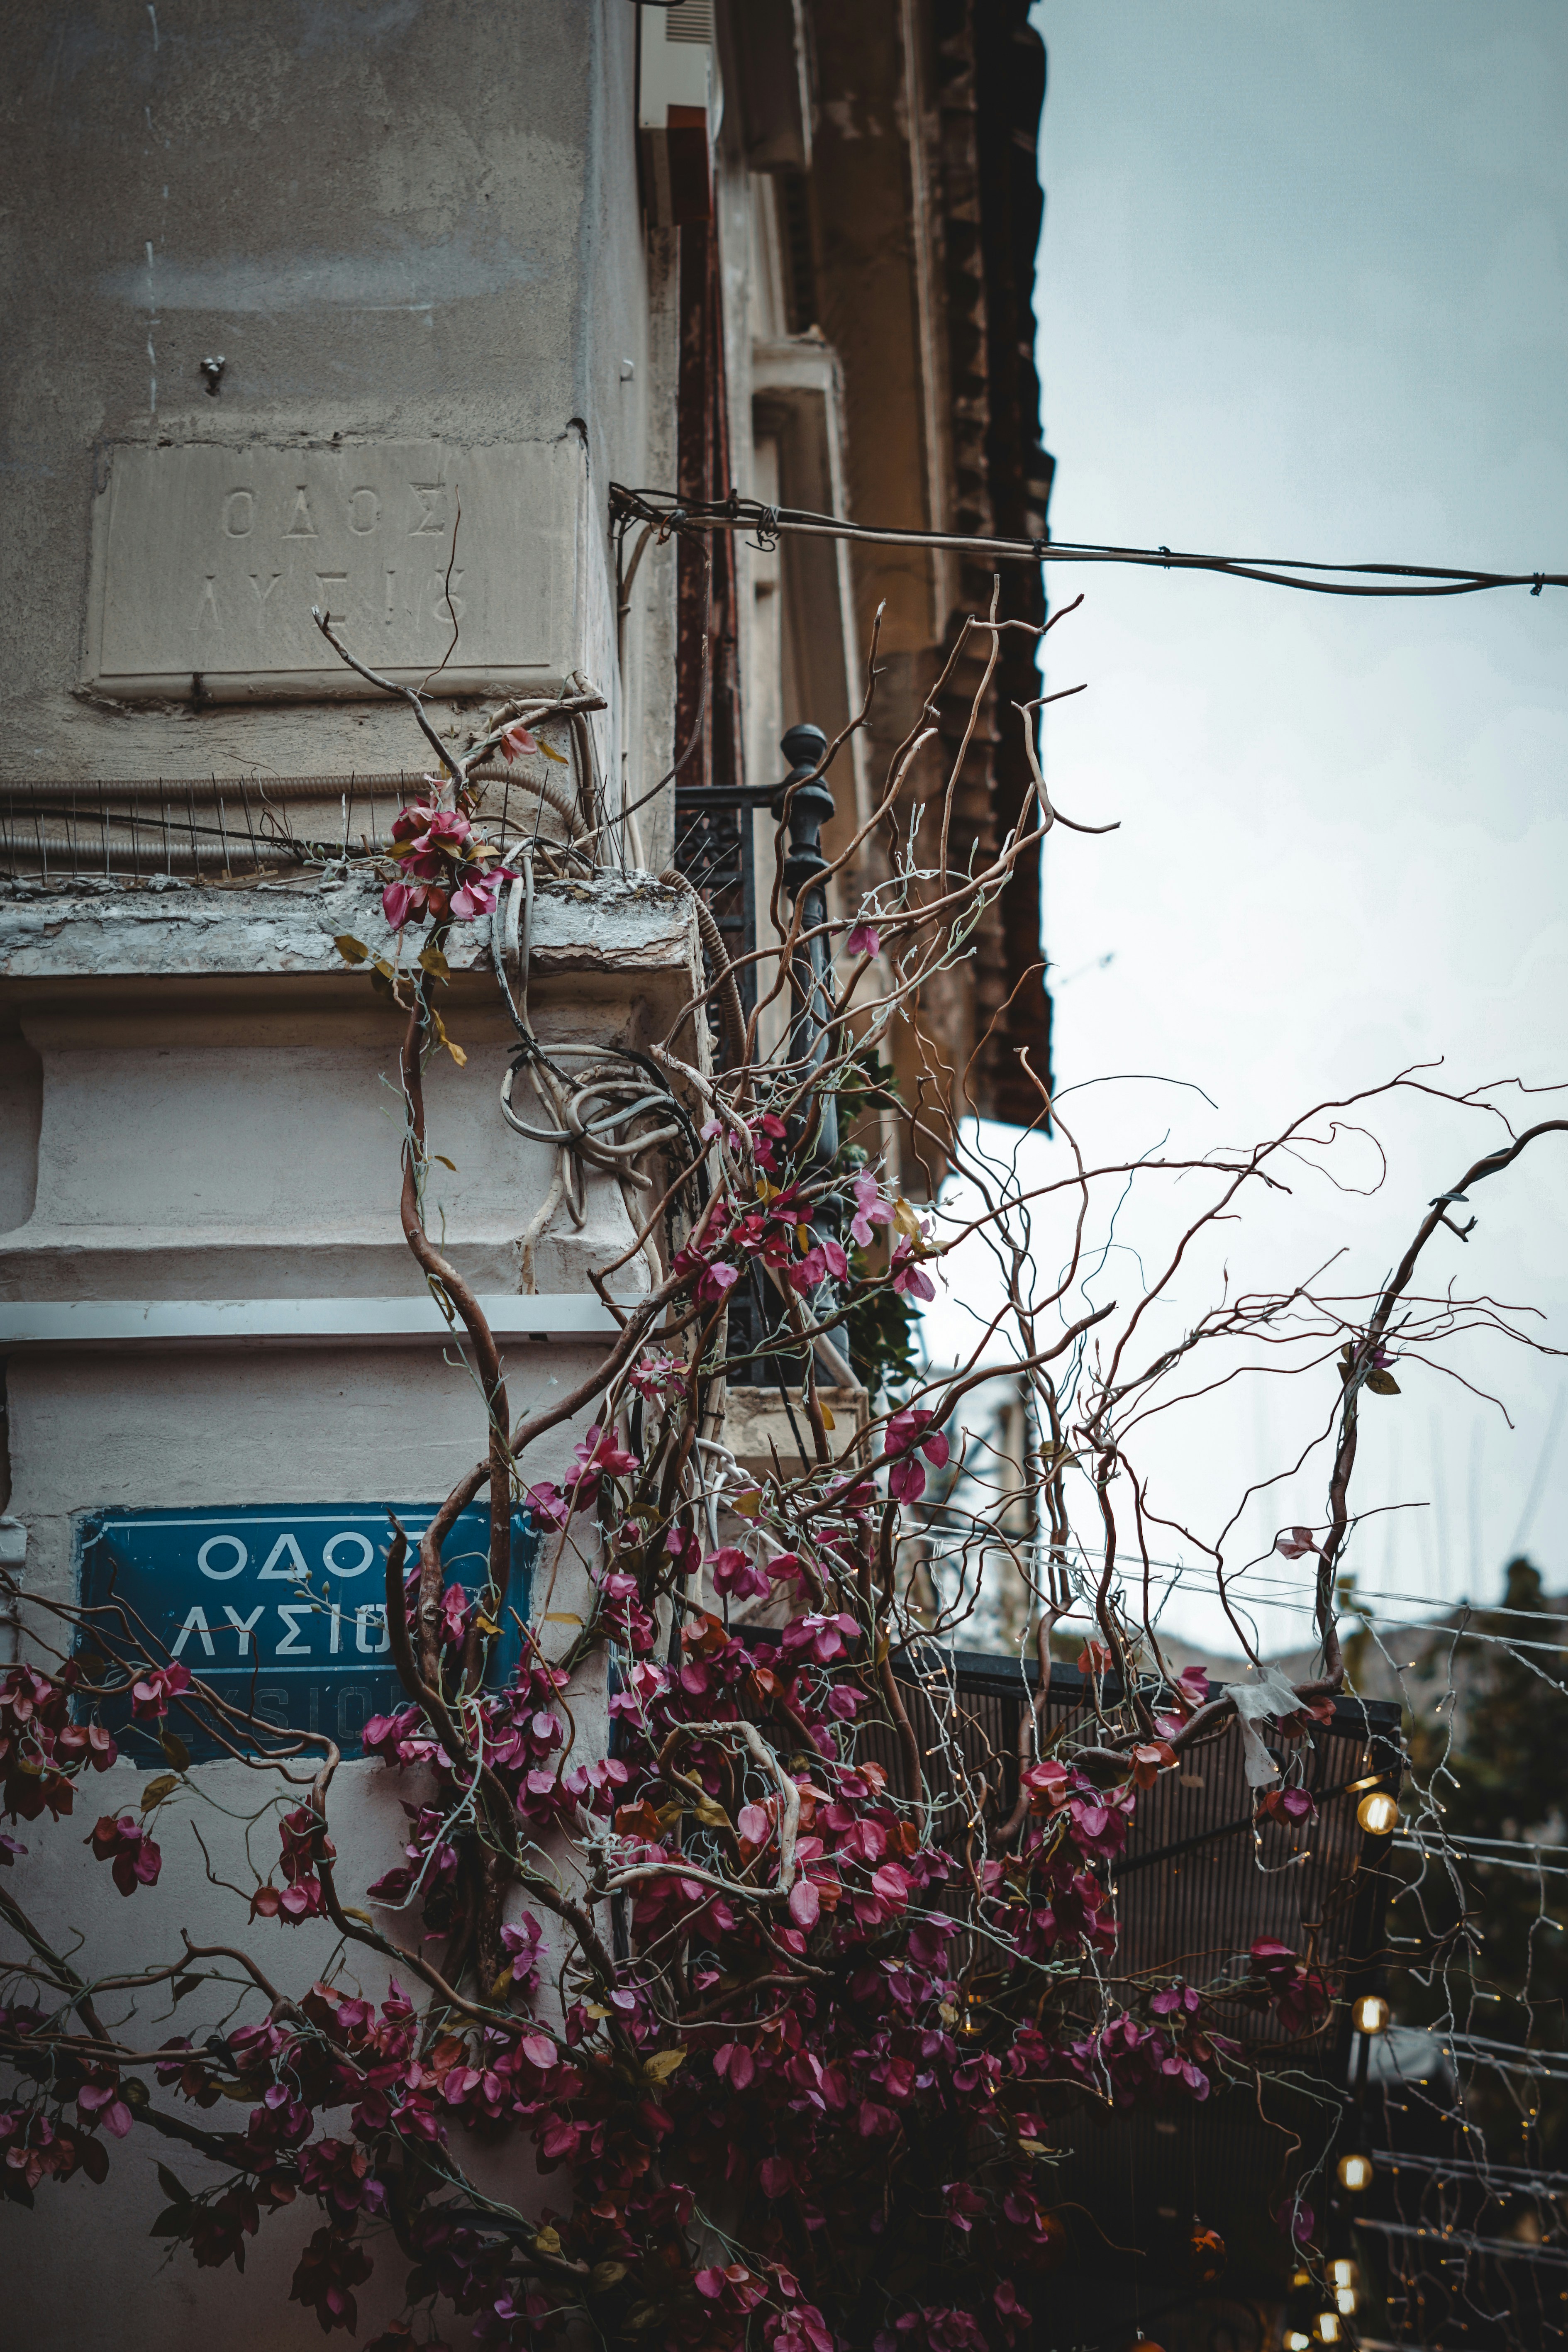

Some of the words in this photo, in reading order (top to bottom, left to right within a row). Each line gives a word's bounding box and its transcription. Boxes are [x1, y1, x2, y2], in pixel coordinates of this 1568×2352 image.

[221, 482, 446, 539] ΟΔΟΣ
[171, 1604, 391, 1656] ΛΥΣΙΟ
[161, 1685, 400, 1743] LYSIO
